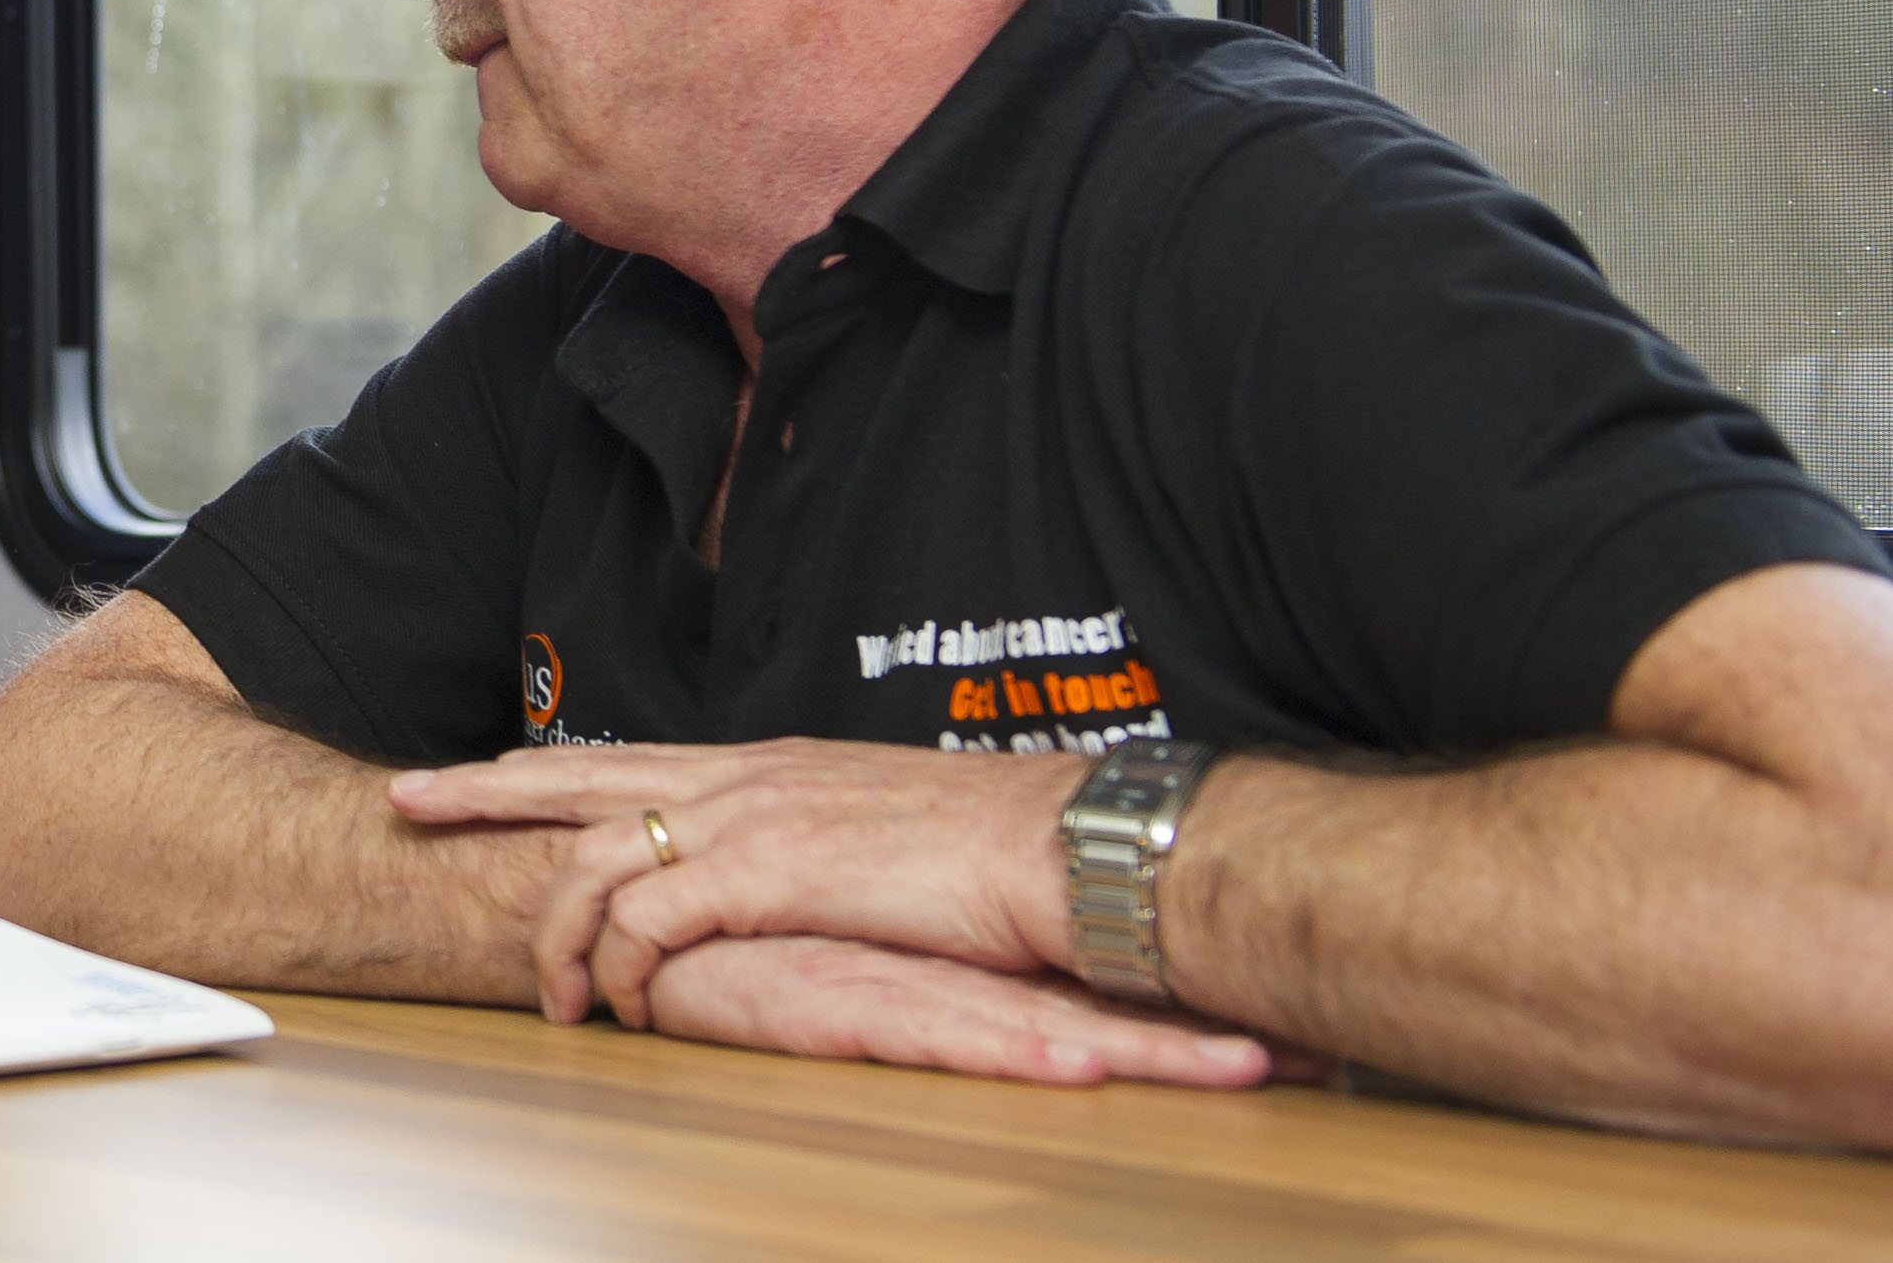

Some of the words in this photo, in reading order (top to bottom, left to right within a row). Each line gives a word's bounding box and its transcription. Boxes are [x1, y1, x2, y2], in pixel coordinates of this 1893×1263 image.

[1006, 604, 1138, 659] cancer
[1001, 669, 1045, 717] in
[1043, 658, 1161, 714] touch
[1055, 708, 1172, 756] bod
